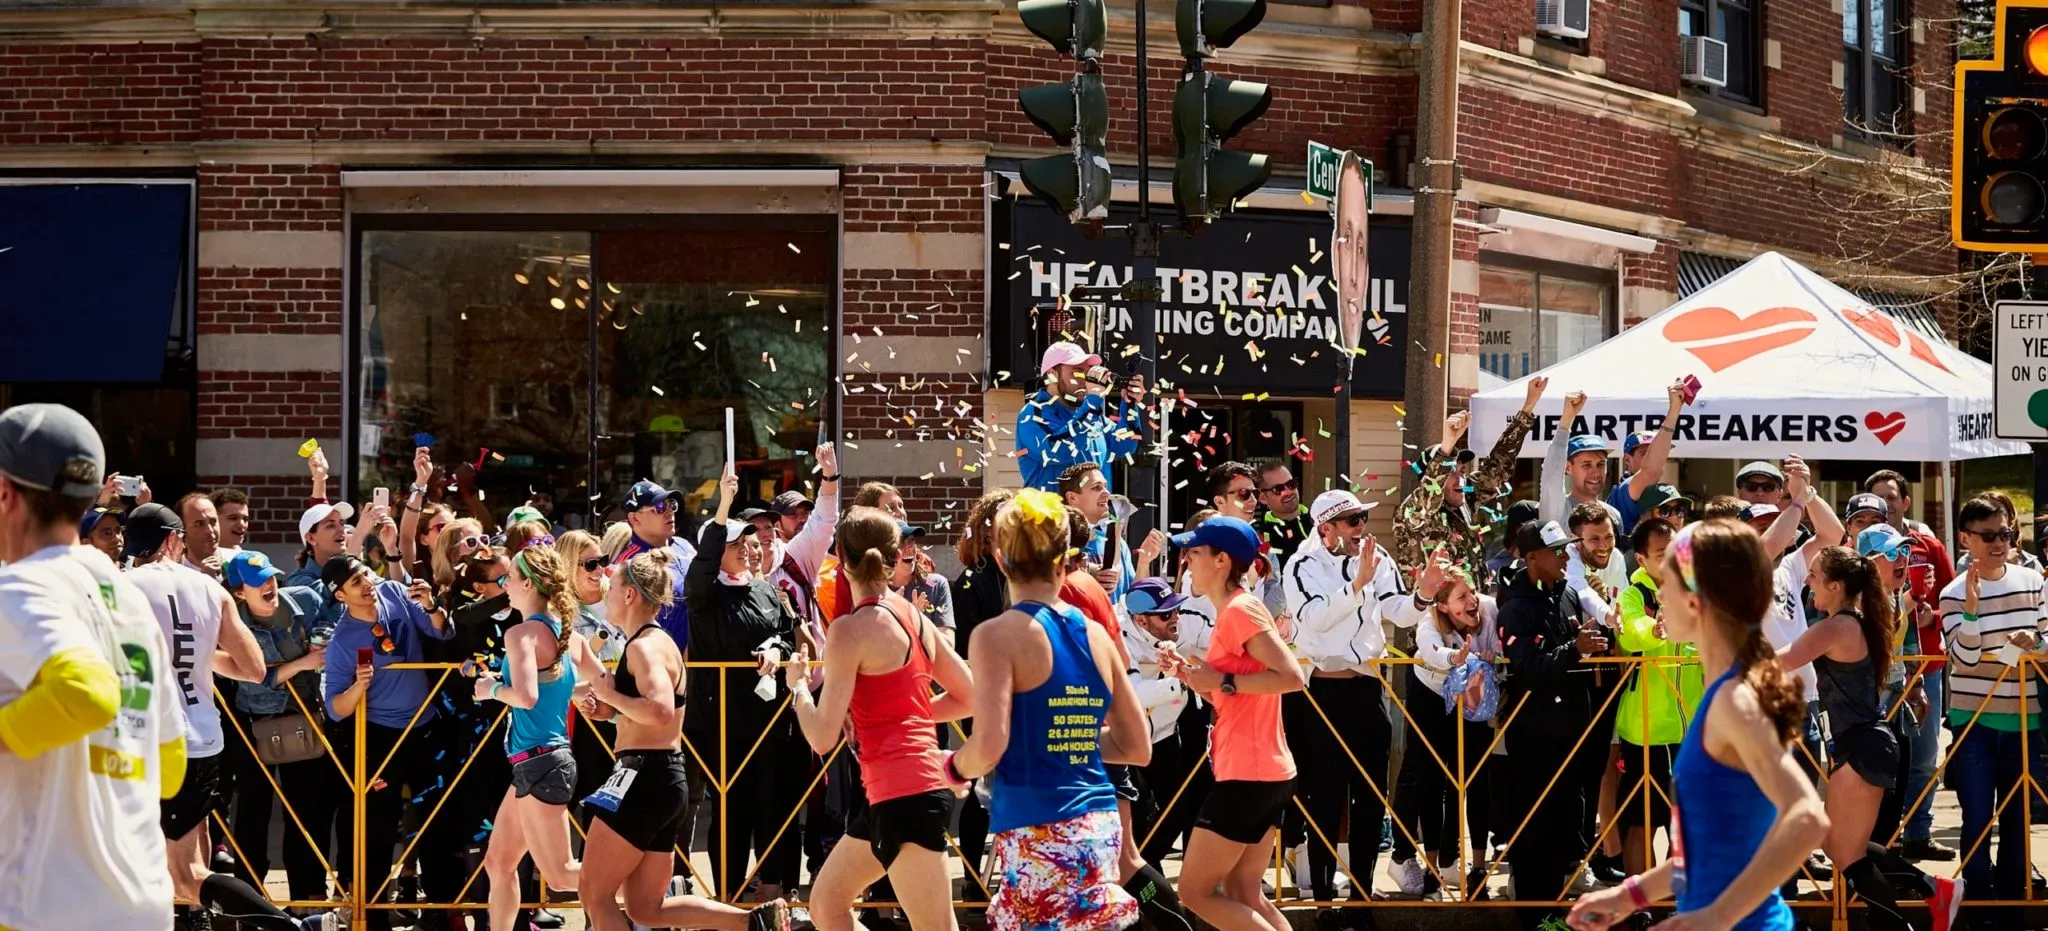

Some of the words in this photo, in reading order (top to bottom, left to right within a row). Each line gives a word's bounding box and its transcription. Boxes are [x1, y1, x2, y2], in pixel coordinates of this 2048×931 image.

[1314, 150, 1341, 192] Cent
[1032, 262, 1326, 309] HEATBREAK
[1104, 307, 1214, 335] UNING
[1224, 311, 1337, 339] COMPAN
[2011, 314, 2044, 329] LEFT
[2012, 365, 2031, 382] ON
[167, 594, 200, 706] LEE
[1048, 697, 1088, 707] MARATHON
[1089, 698, 1104, 707] CLUB
[1053, 715, 1065, 725] 50
[1048, 729, 1070, 739] 26.2
[1047, 742, 1069, 752] sub4
[1070, 741, 1096, 752] HOURS
